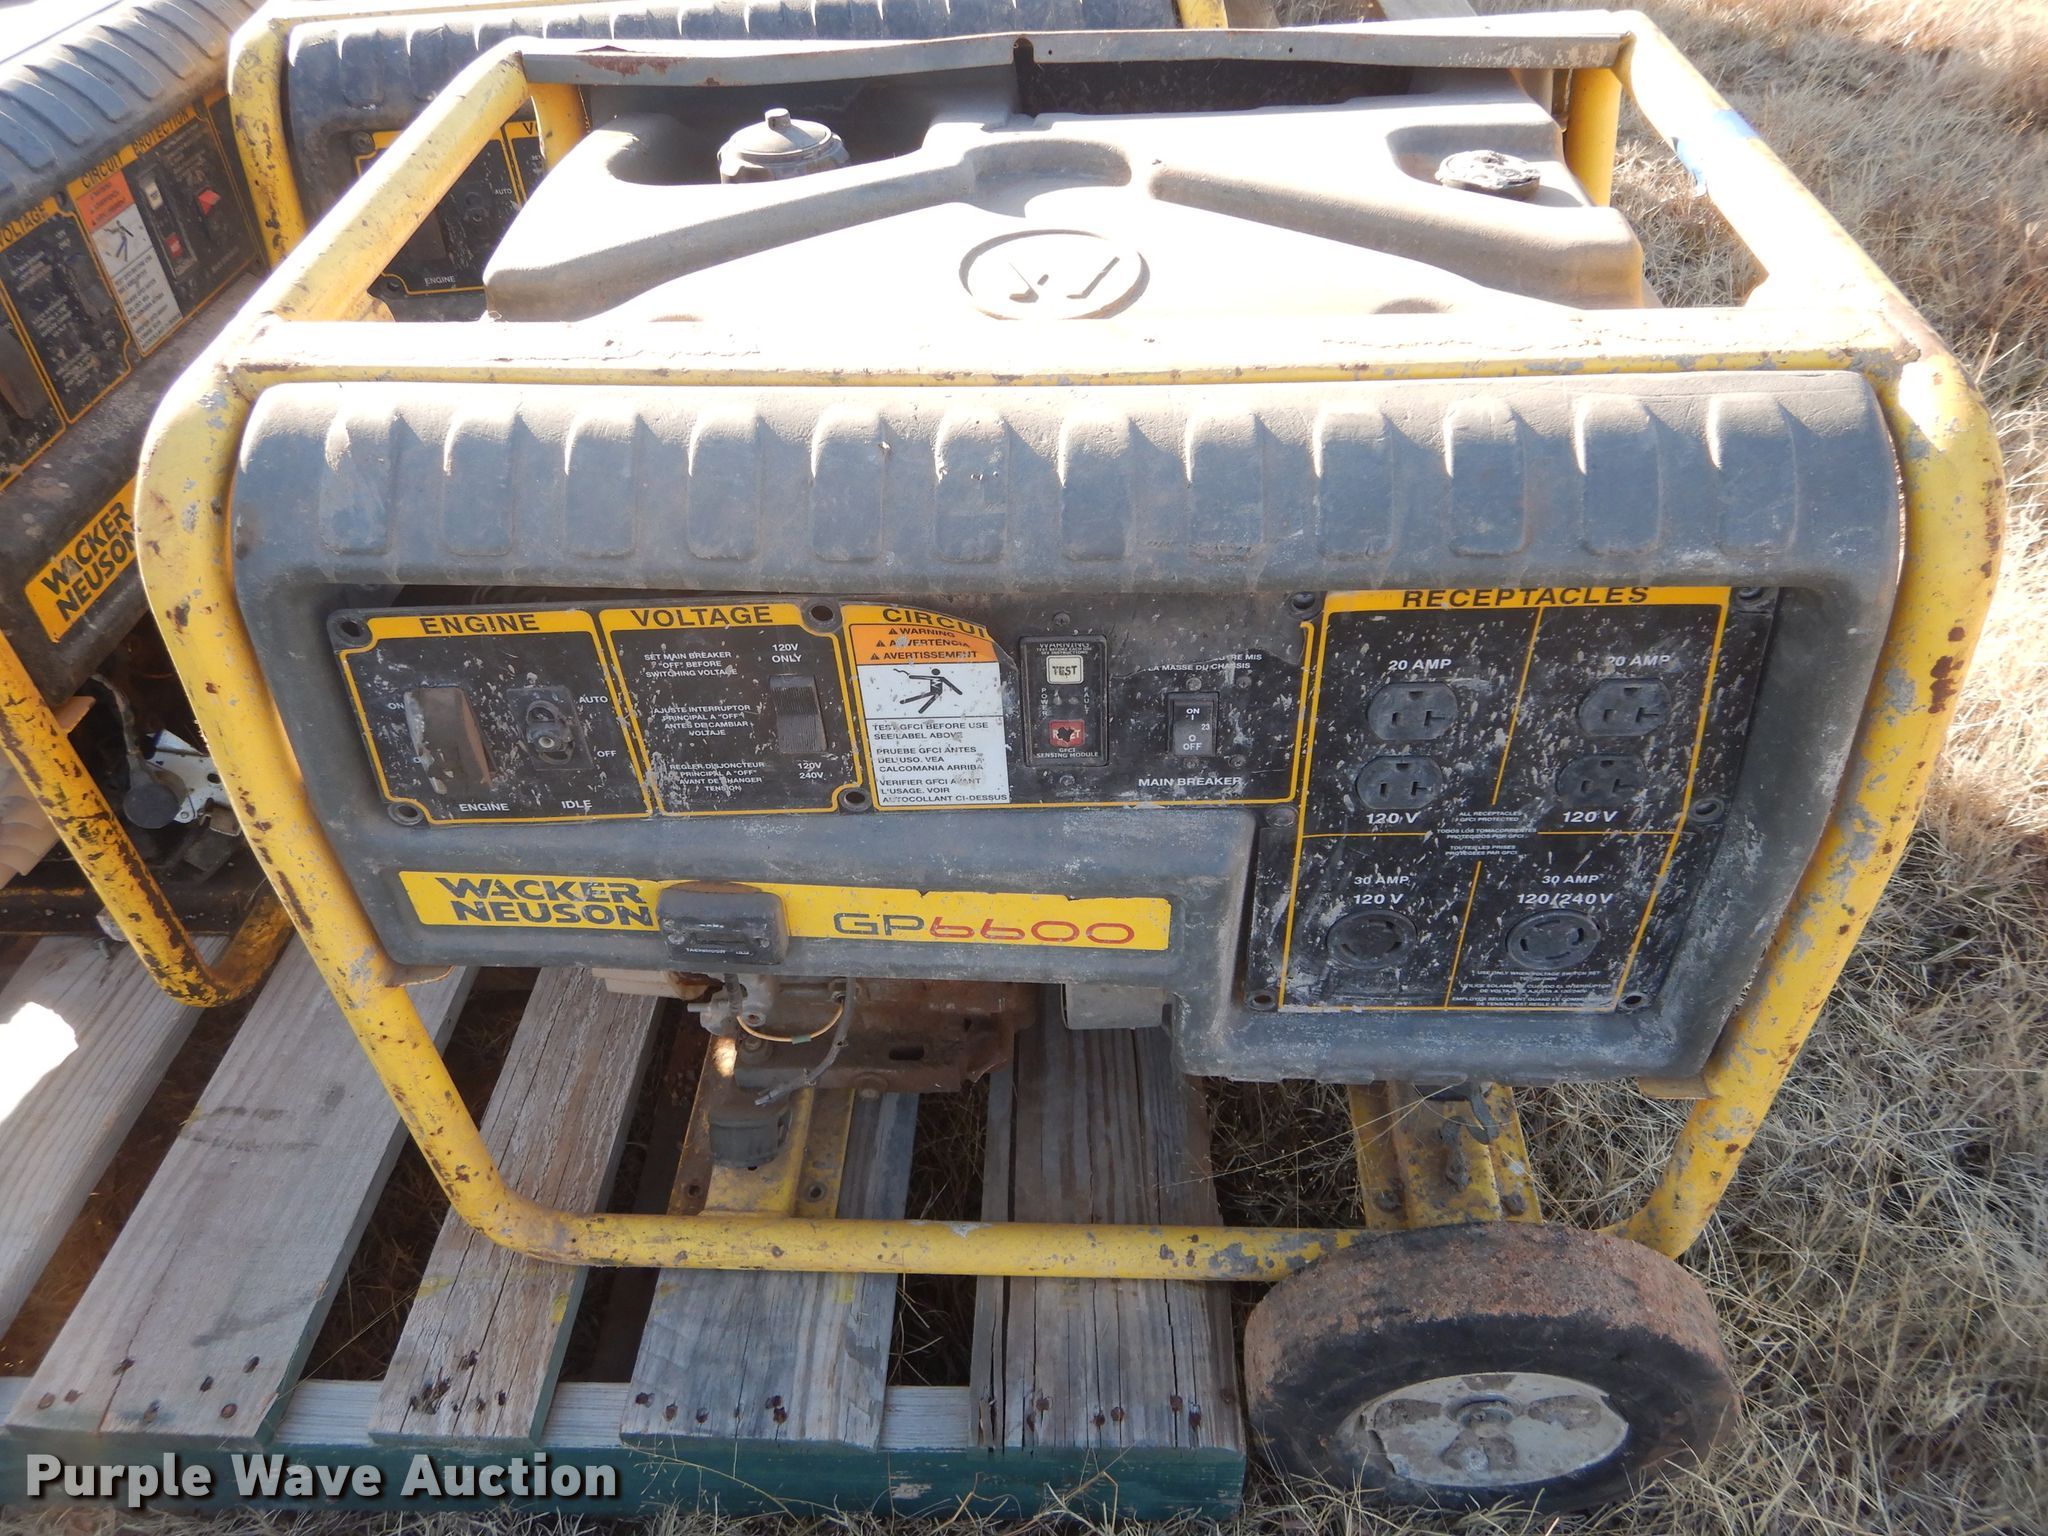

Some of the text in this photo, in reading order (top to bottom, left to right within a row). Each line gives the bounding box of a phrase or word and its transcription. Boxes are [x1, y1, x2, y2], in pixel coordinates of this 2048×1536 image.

[81, 154, 124, 189] CIRCUIT
[133, 110, 190, 155] PROTECTION
[424, 276, 456, 285] ENGINE
[1402, 587, 1649, 608] RECEPTACLES
[630, 606, 773, 627] VOLTAGE
[419, 614, 540, 635] ENGINE
[899, 628, 956, 638] WARNING
[772, 643, 799, 652] 120V
[889, 639, 970, 648] AVERTENCIA
[644, 651, 732, 661] SET MAIN BREAKER
[771, 654, 802, 664] ONLY
[883, 651, 978, 660] AVERTISSEMENT
[1245, 653, 1262, 661] MIS
[1629, 655, 1671, 666] AMP
[685, 660, 722, 668] BEFORE
[1388, 658, 1452, 671] 20 AMP
[645, 670, 696, 678] SWITCHING
[1052, 665, 1078, 676] TEST
[387, 702, 405, 710] ON
[1040, 687, 1049, 716] POWER
[653, 704, 751, 714] AJUSTE INTERRUPTOR
[664, 722, 692, 730] ANTES
[708, 720, 749, 728] CAMBIAR
[926, 722, 966, 730] BEFORE
[968, 721, 989, 729] USE
[896, 732, 927, 740] LABEL
[1183, 743, 1202, 751] OFF
[597, 750, 617, 758] OFF
[705, 761, 765, 769] DISJONCTEUR
[797, 762, 822, 770] 120V
[880, 765, 945, 773] CALCOMANIA
[879, 778, 923, 786] VERIFIER
[1138, 777, 1242, 787] MAIN BREAKER
[459, 803, 510, 812] ENGINE
[561, 800, 593, 809] IDLE
[1366, 812, 1420, 824] 120 V
[1563, 811, 1618, 823] 120 V
[1354, 876, 1410, 885] 30 AMP
[1541, 874, 1599, 884] 30 AMP
[434, 877, 648, 903] WACKER
[1353, 893, 1404, 904] 120 V
[1517, 892, 1614, 905] 120/240 V
[450, 900, 654, 927] NEUSON
[833, 911, 1135, 945] GP6600
